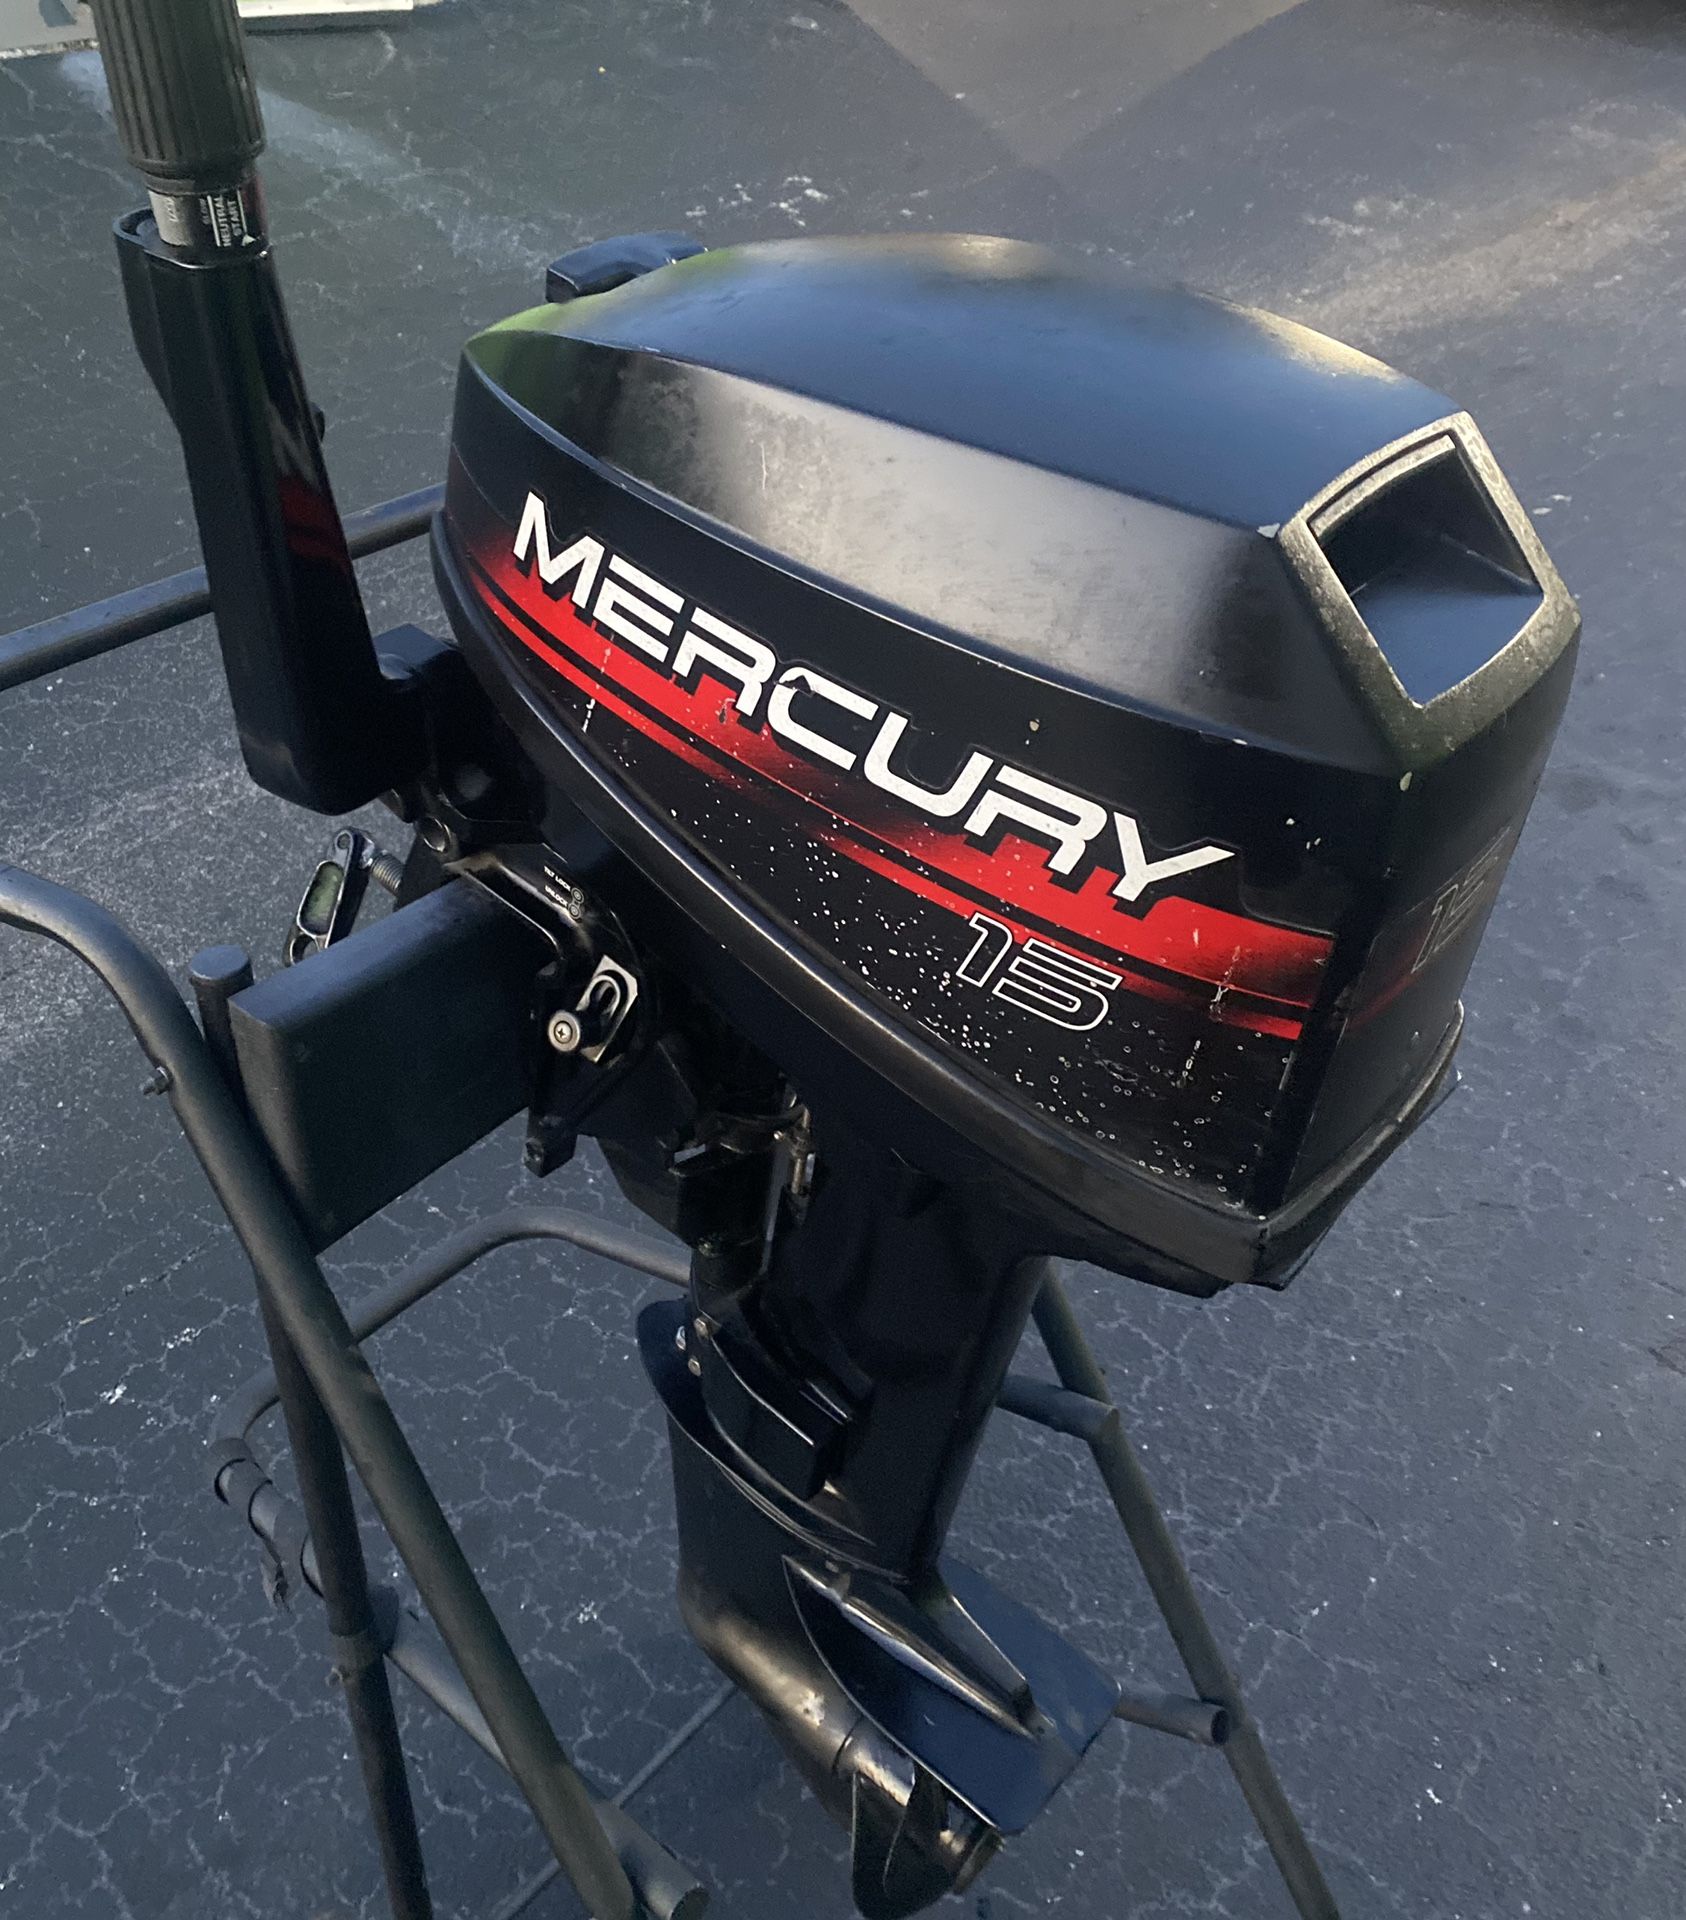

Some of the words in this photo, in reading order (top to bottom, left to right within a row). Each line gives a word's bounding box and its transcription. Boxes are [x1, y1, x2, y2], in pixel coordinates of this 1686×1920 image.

[214, 195, 231, 246] NEUTRAL
[227, 200, 242, 236] START
[512, 491, 1235, 901] MERCURY
[545, 885, 568, 906] UNLOCK
[555, 875, 570, 891] LOCK
[955, 912, 1123, 1032] 15
